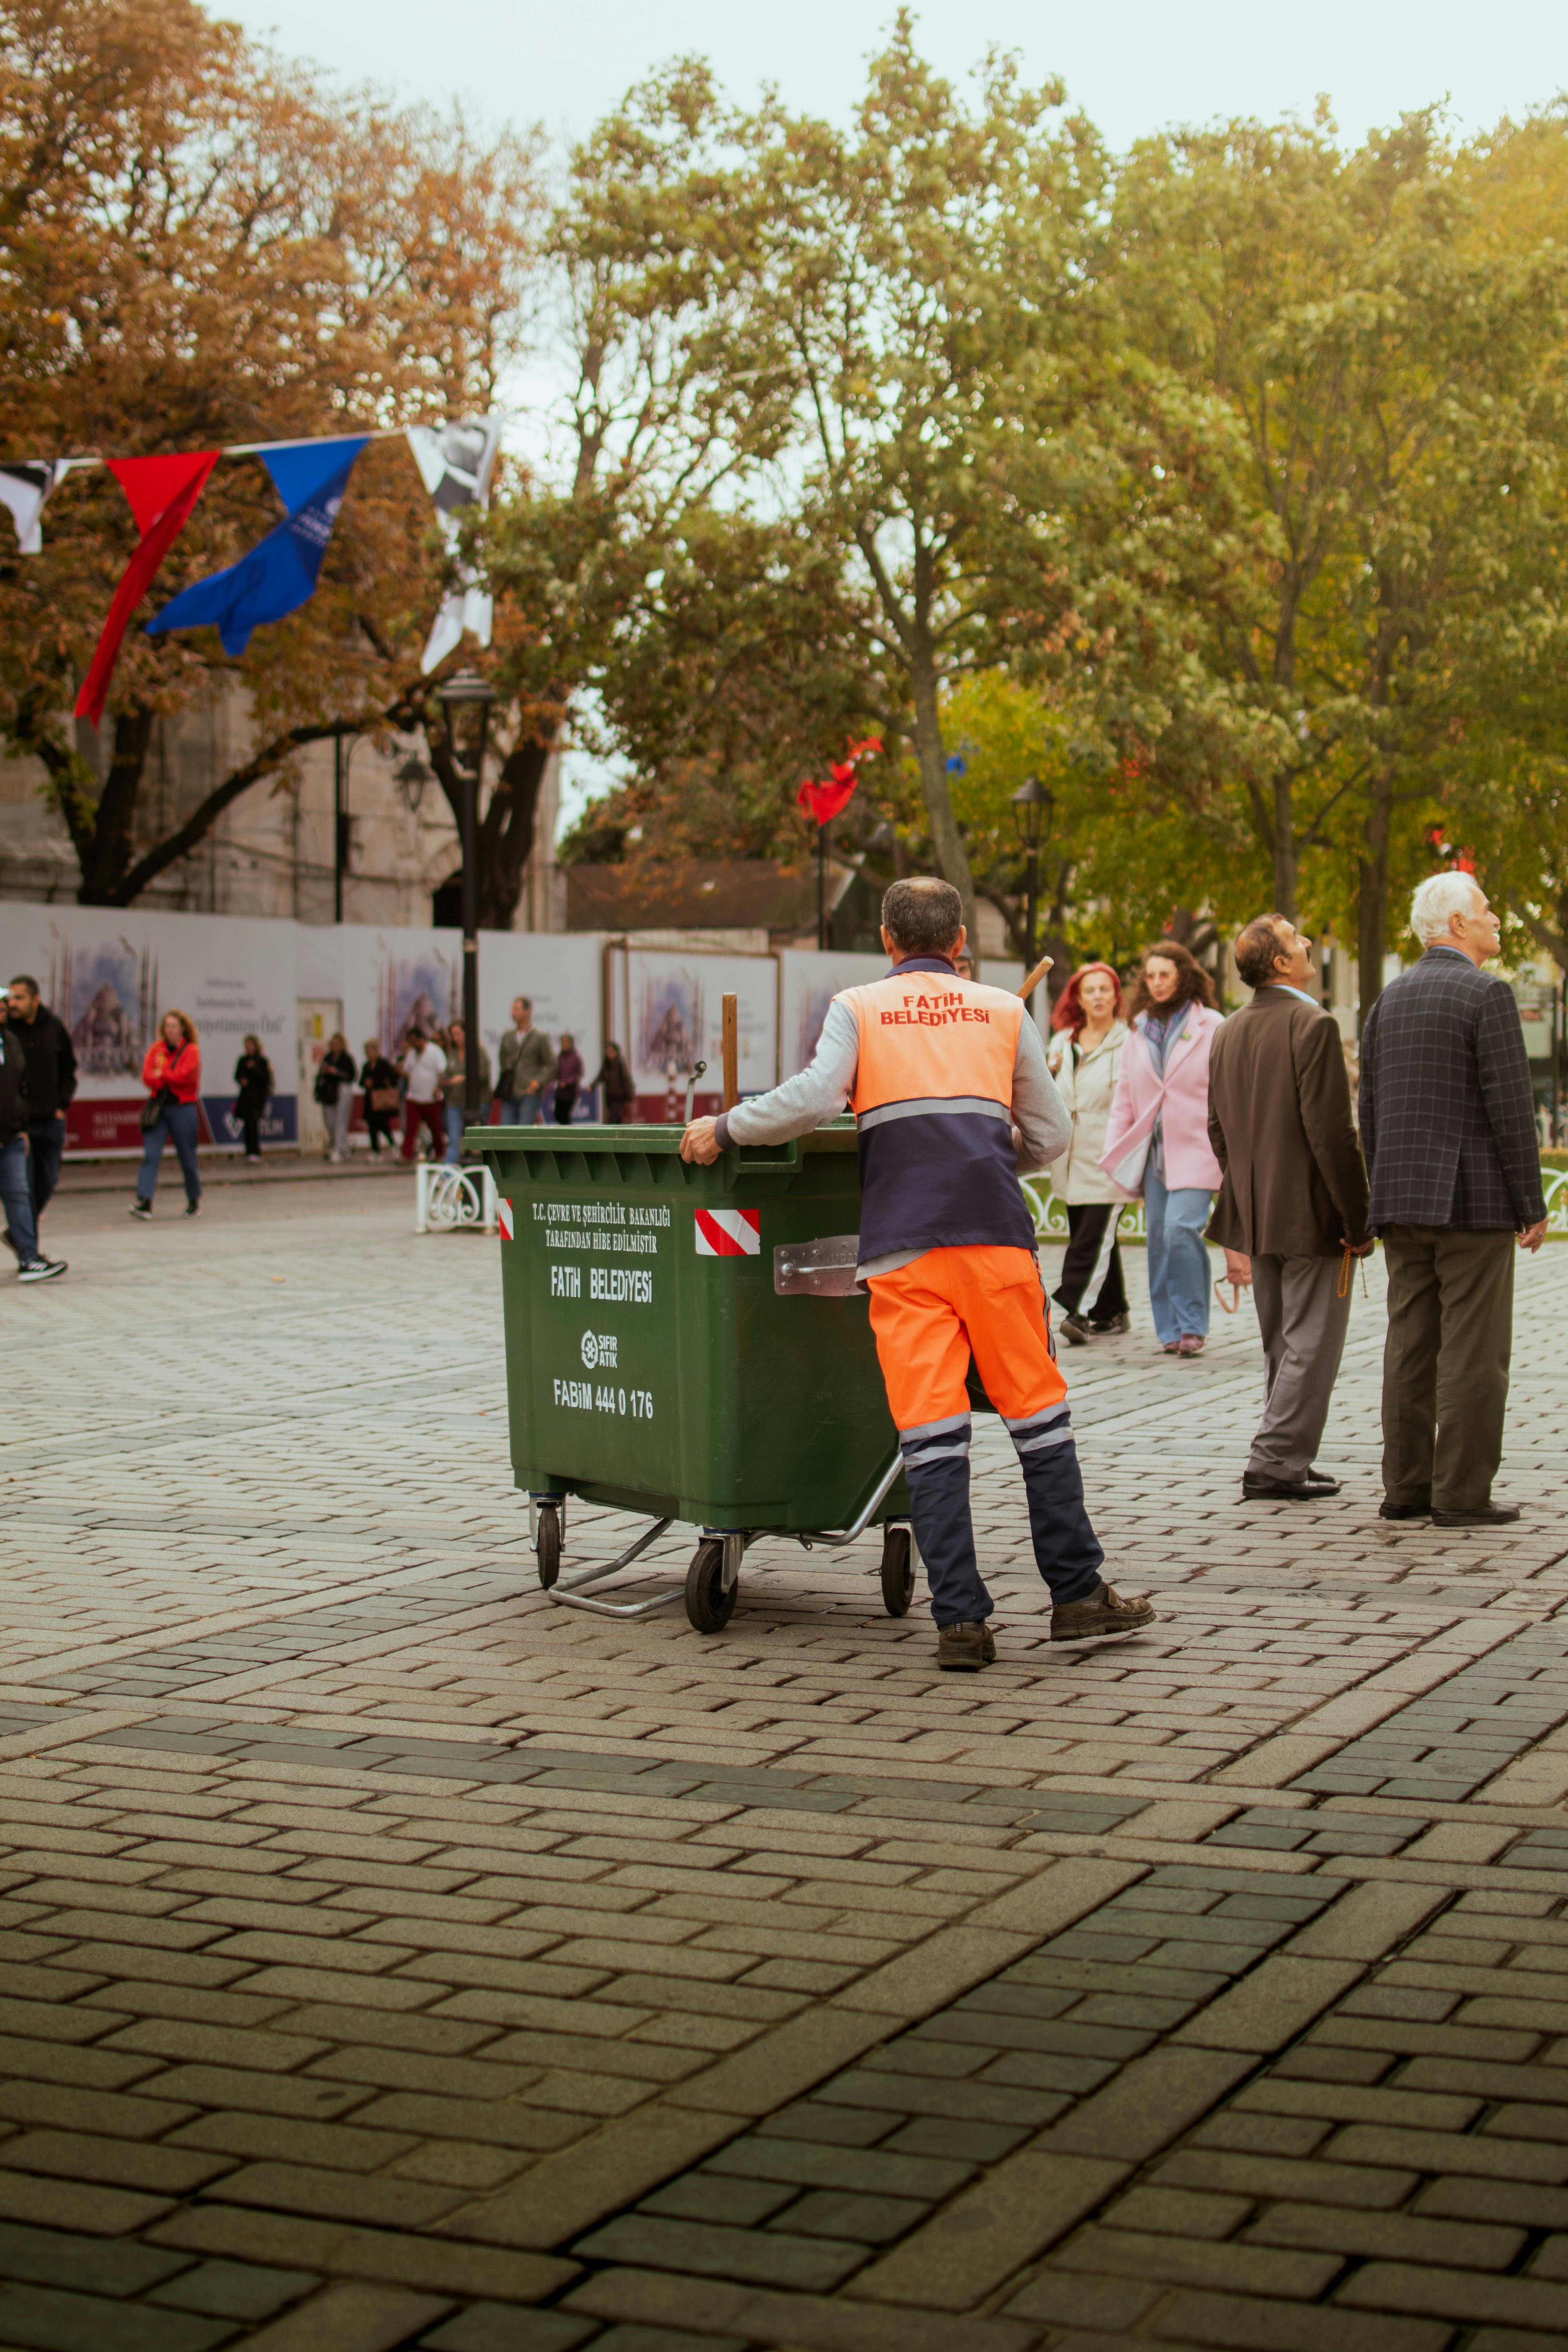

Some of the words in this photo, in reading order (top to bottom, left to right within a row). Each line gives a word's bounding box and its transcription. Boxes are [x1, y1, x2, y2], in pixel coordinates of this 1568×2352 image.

[533, 1203, 546, 1220] T.C.
[548, 1204, 570, 1225] ÇEVRE
[571, 1205, 581, 1222] VE
[546, 1230, 591, 1249] TARAFINDAN
[593, 1228, 611, 1250] HİBE
[598, 1335, 617, 1351] SIFIR
[599, 1351, 618, 1368] ATIK
[595, 1385, 615, 1414] 444
[618, 1388, 626, 1415] 0
[630, 1390, 653, 1419] 176
